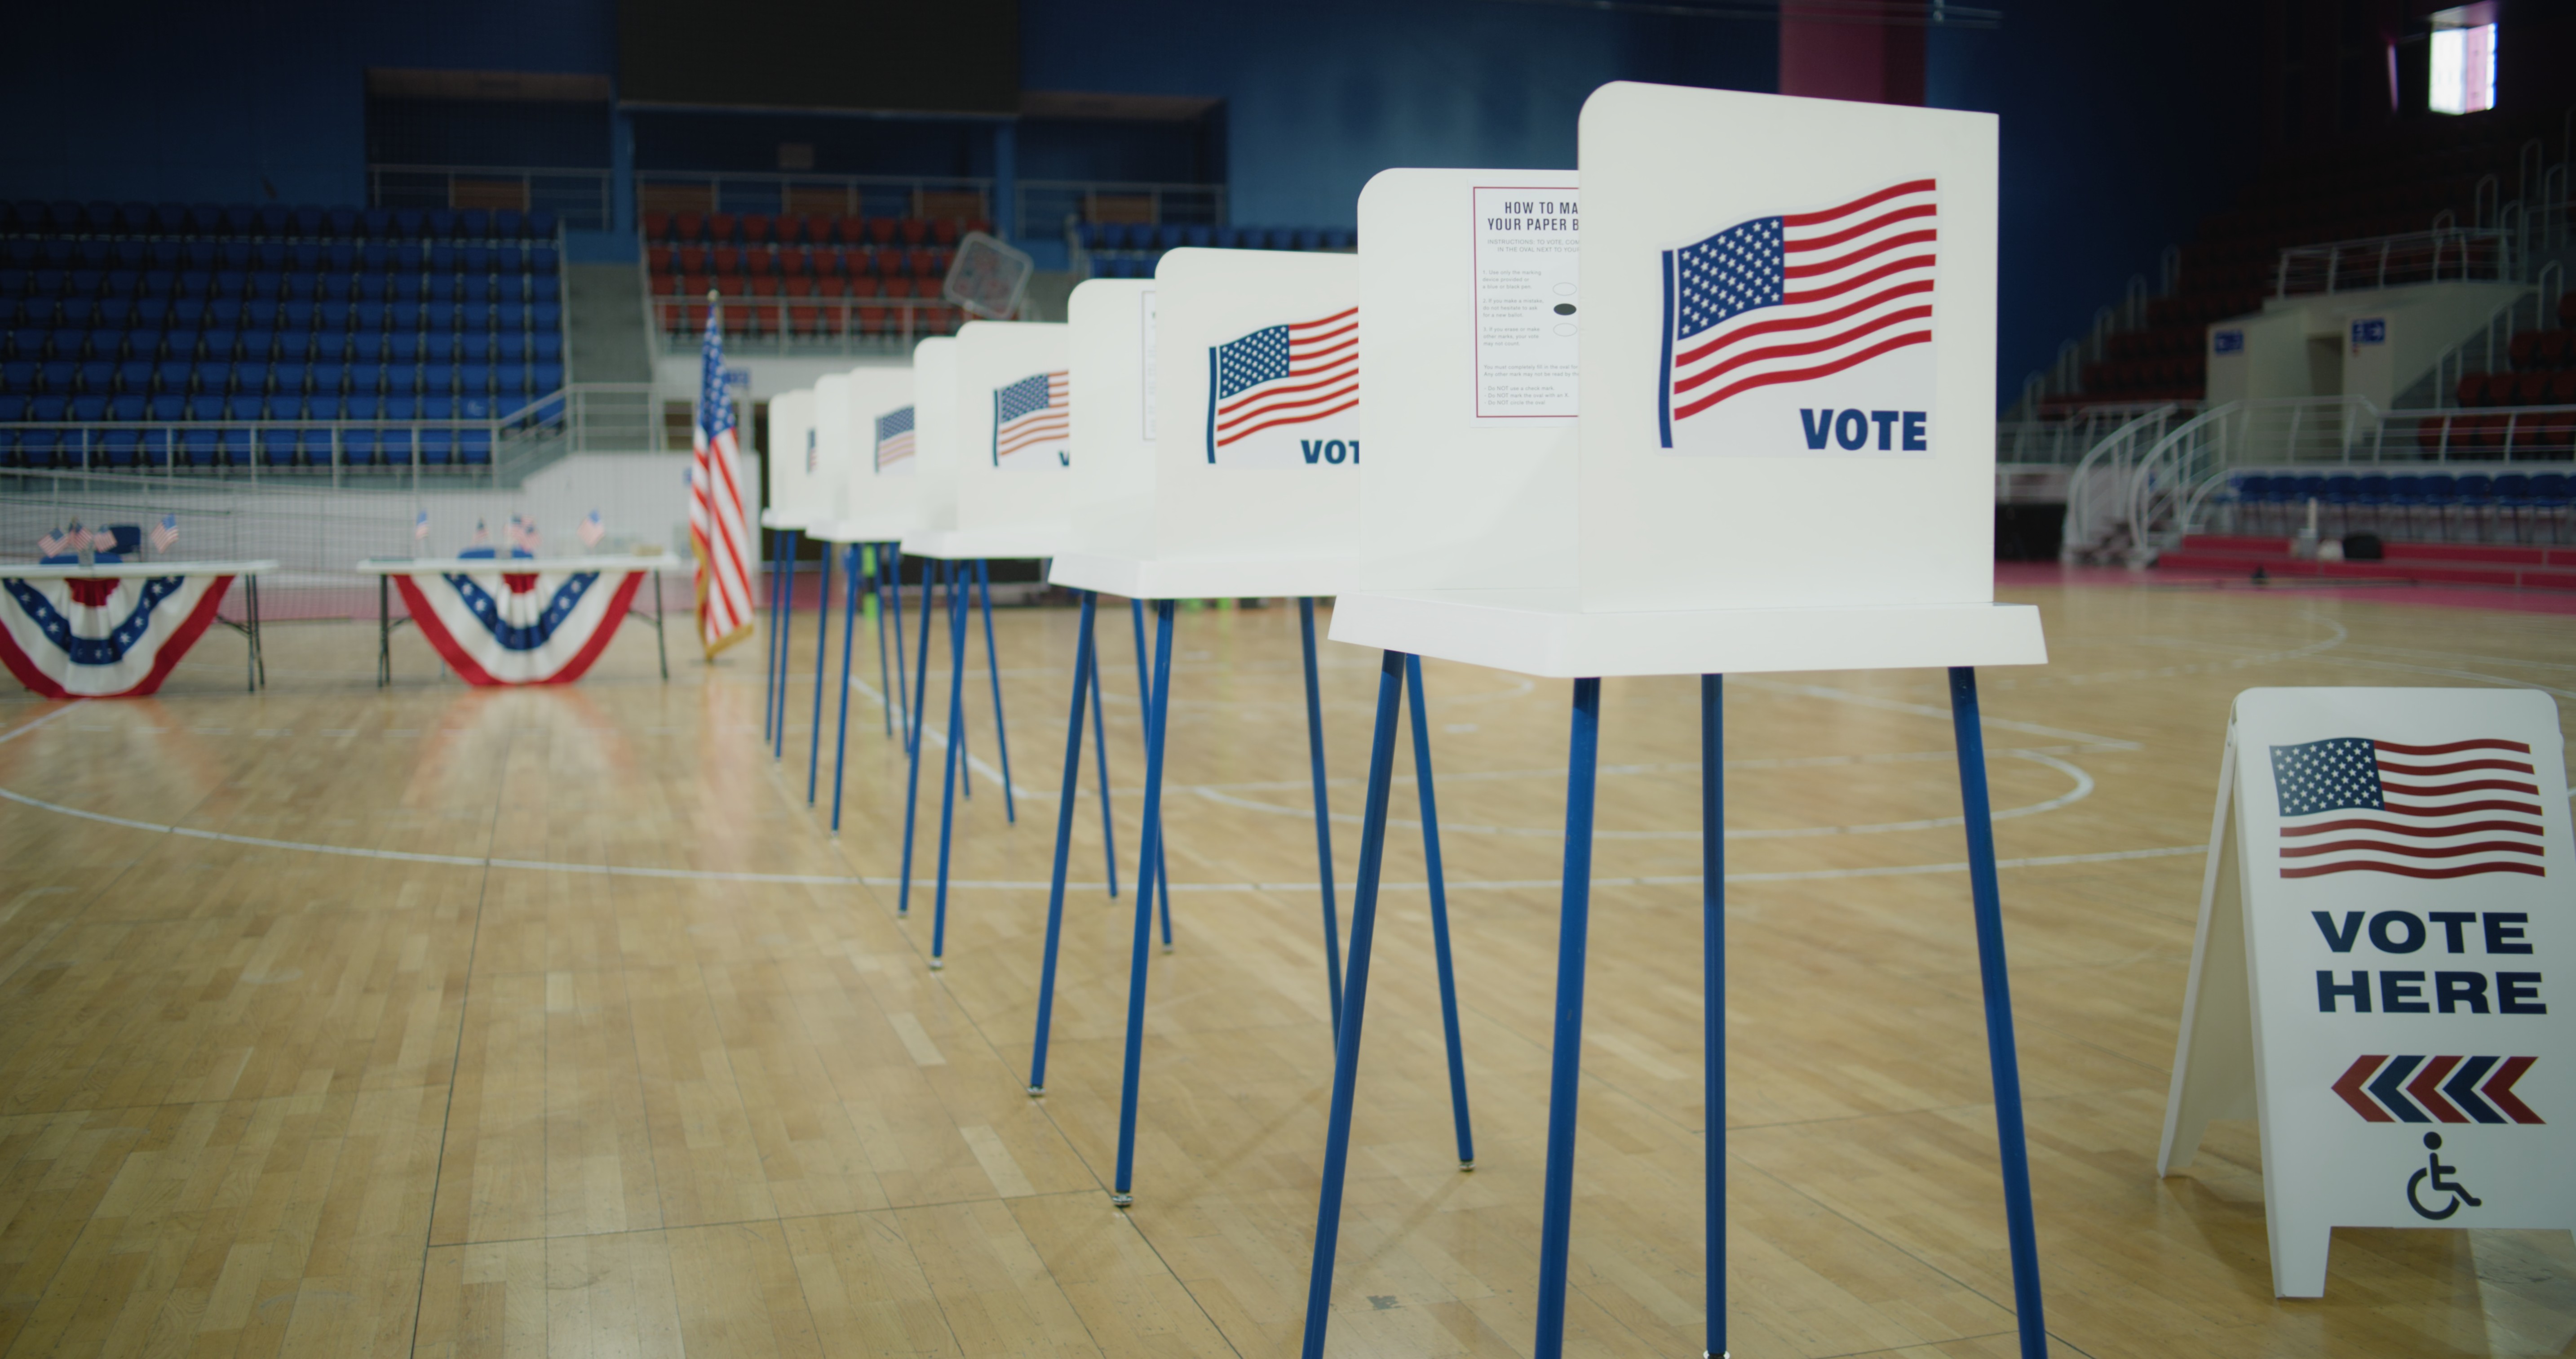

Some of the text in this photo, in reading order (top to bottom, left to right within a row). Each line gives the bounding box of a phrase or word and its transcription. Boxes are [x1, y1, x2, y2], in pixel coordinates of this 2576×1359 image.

[1488, 218, 1521, 231] YOUR
[1527, 218, 1567, 231] PAPER
[1505, 202, 1533, 214] HOW
[1539, 202, 1554, 214] TO
[1799, 408, 1926, 451] VOTE
[2311, 910, 2533, 954] VOTE
[2316, 970, 2547, 1014] HERE
